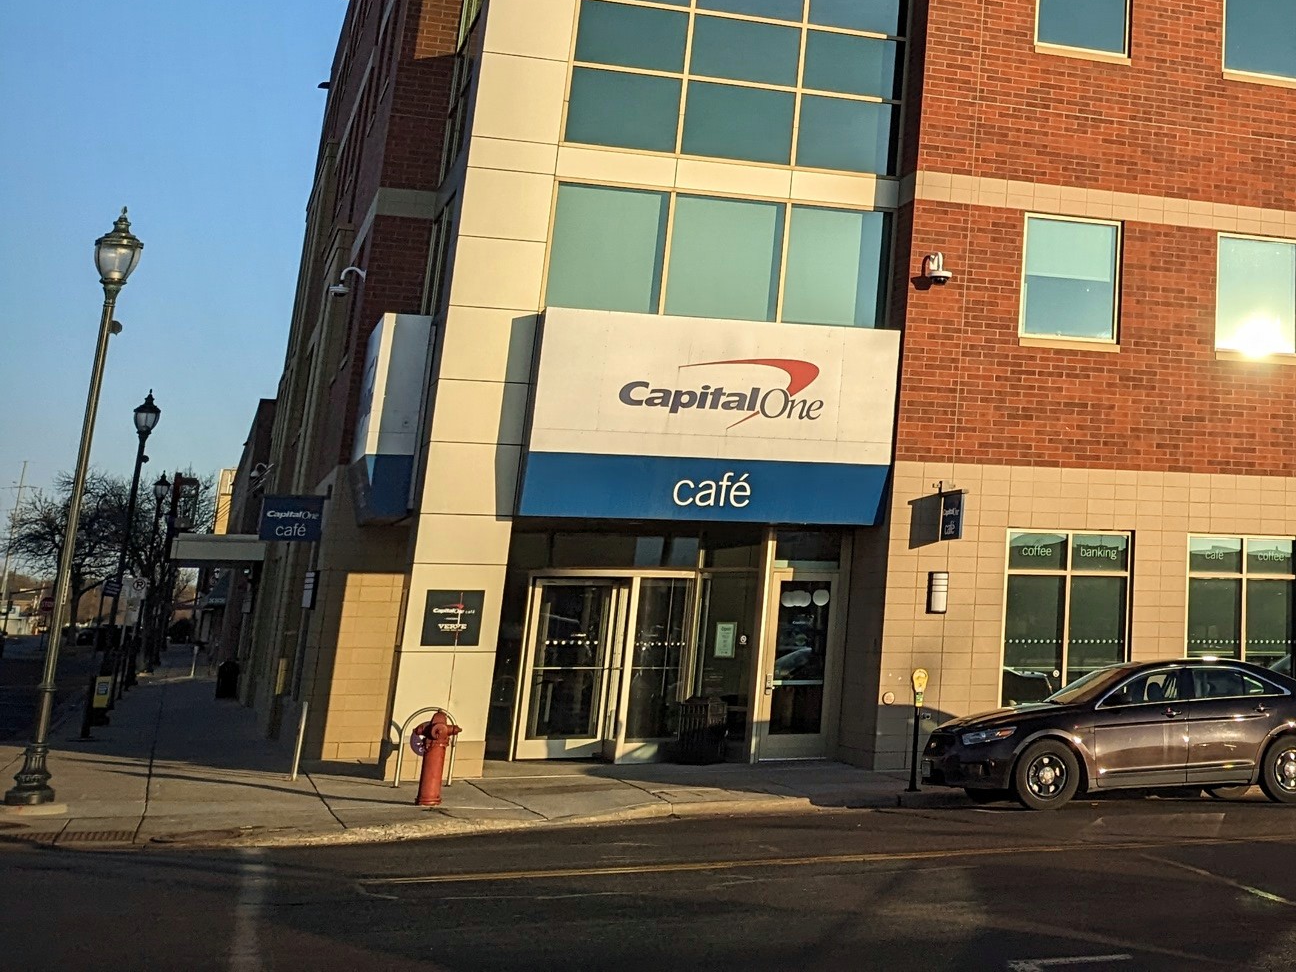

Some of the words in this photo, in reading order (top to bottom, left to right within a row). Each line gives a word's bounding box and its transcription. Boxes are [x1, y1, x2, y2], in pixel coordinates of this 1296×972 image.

[672, 471, 751, 508] café
[275, 523, 306, 536] café
[1022, 545, 1052, 556] coffee
[1080, 546, 1117, 560] banking
[1257, 552, 1285, 562] coffee
